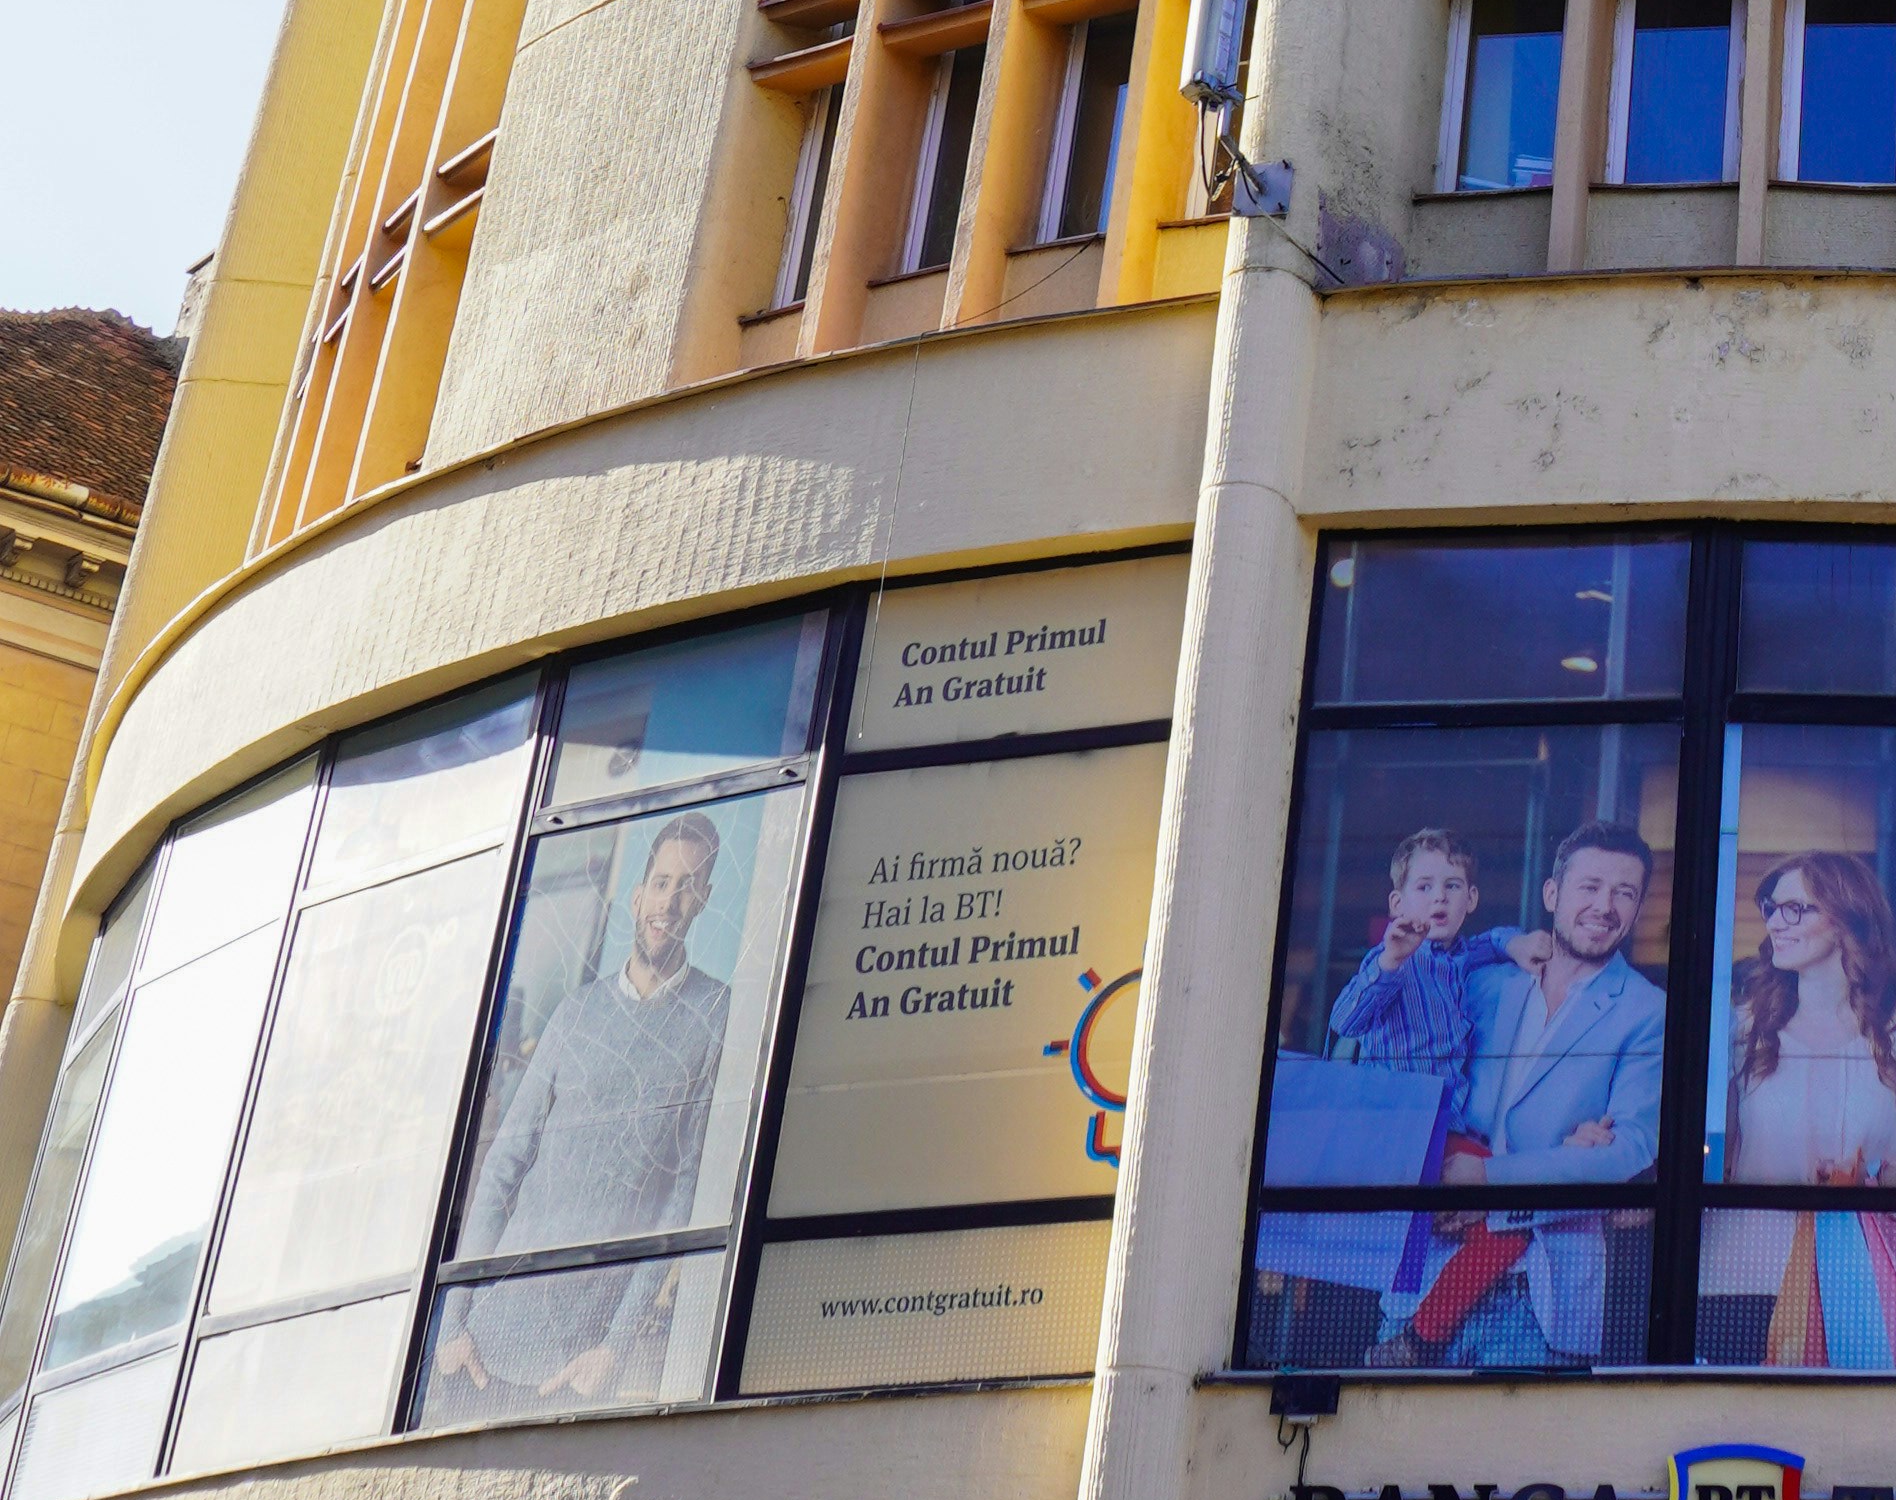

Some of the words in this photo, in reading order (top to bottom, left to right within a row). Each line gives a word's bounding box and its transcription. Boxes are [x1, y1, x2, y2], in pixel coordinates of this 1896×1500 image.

[901, 631, 998, 668] Contul
[1004, 617, 1107, 656] Primul
[892, 682, 933, 708] An
[942, 665, 1047, 702] Gratuit
[868, 855, 900, 885] Ai
[906, 846, 983, 882] firmă
[990, 837, 1082, 873] nouă?
[861, 897, 913, 930] Hai
[918, 895, 946, 924] la
[953, 889, 1004, 921] BT!
[855, 936, 961, 974] Contul
[967, 924, 1081, 964] Primul
[845, 991, 891, 1021] An
[899, 977, 1015, 1016] Gratuit
[820, 1283, 1044, 1319] www.contgratuit.ro
